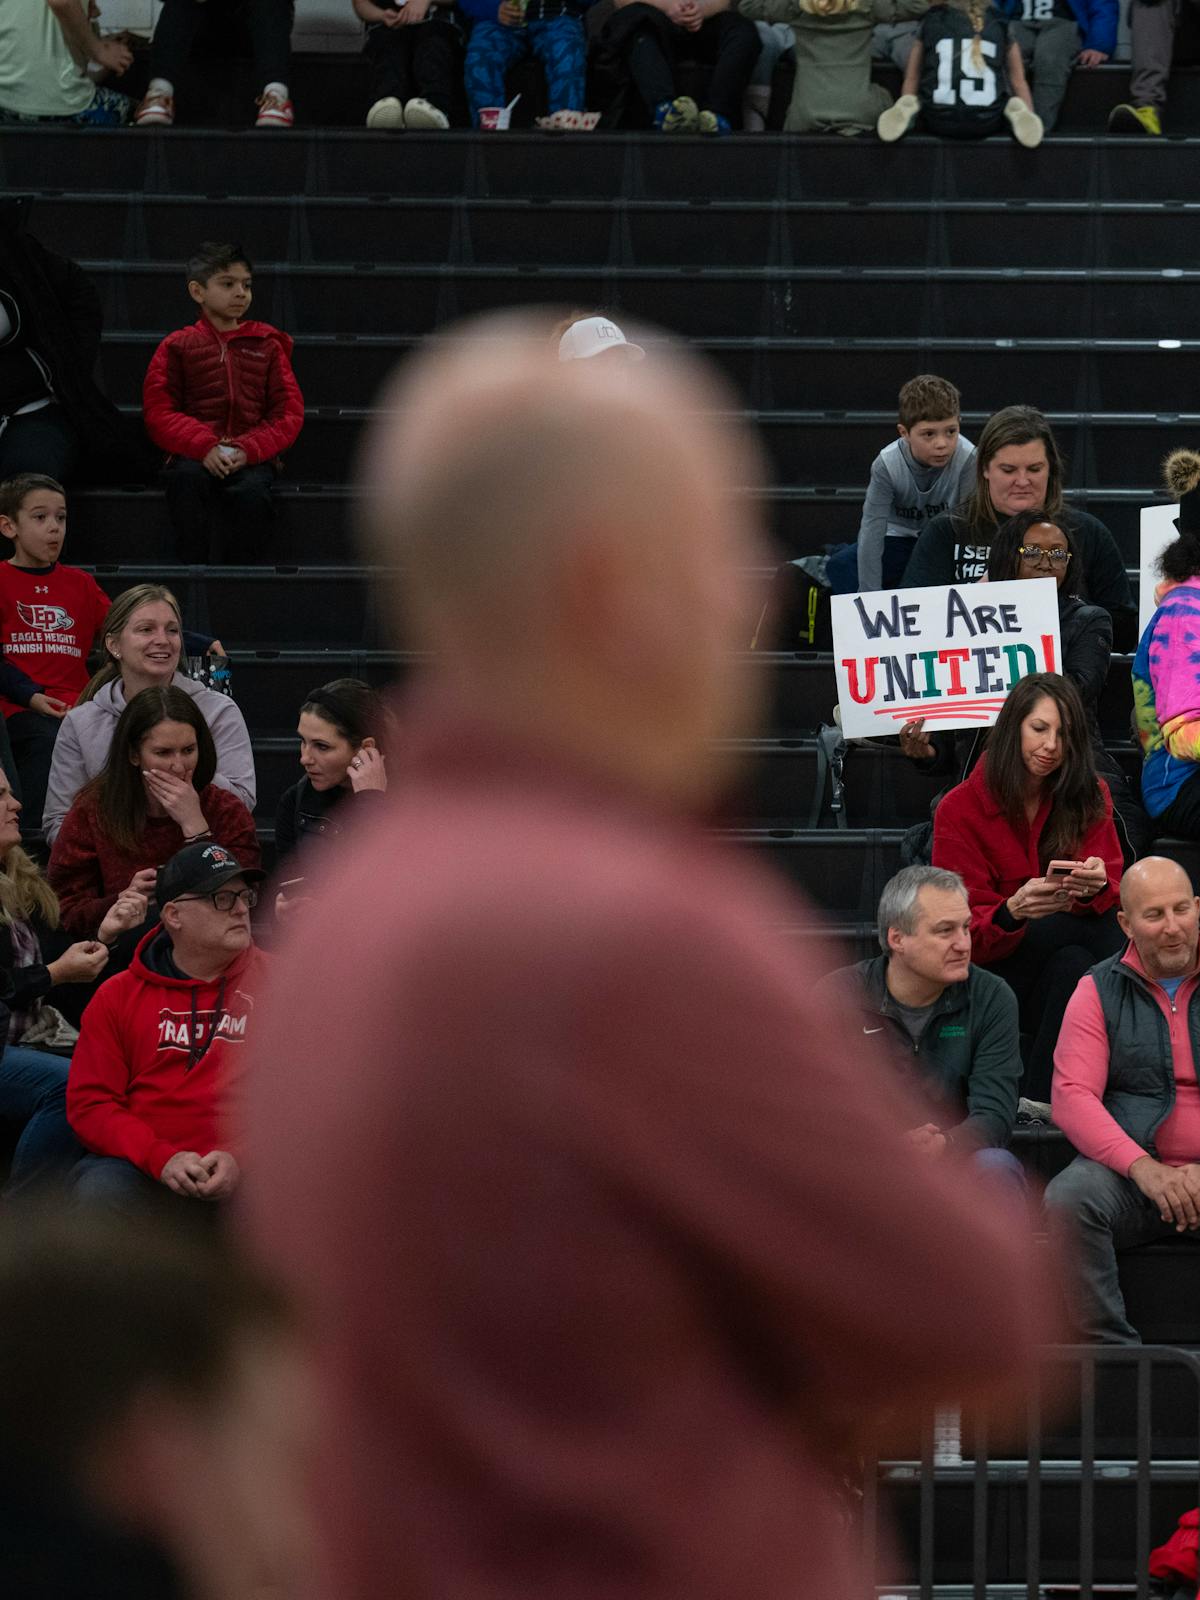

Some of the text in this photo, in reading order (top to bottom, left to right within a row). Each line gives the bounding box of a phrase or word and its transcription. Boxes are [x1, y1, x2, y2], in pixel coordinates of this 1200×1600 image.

[933, 38, 997, 106] 15
[11, 632, 42, 642] EAGLE
[853, 588, 1022, 639] WE ARE
